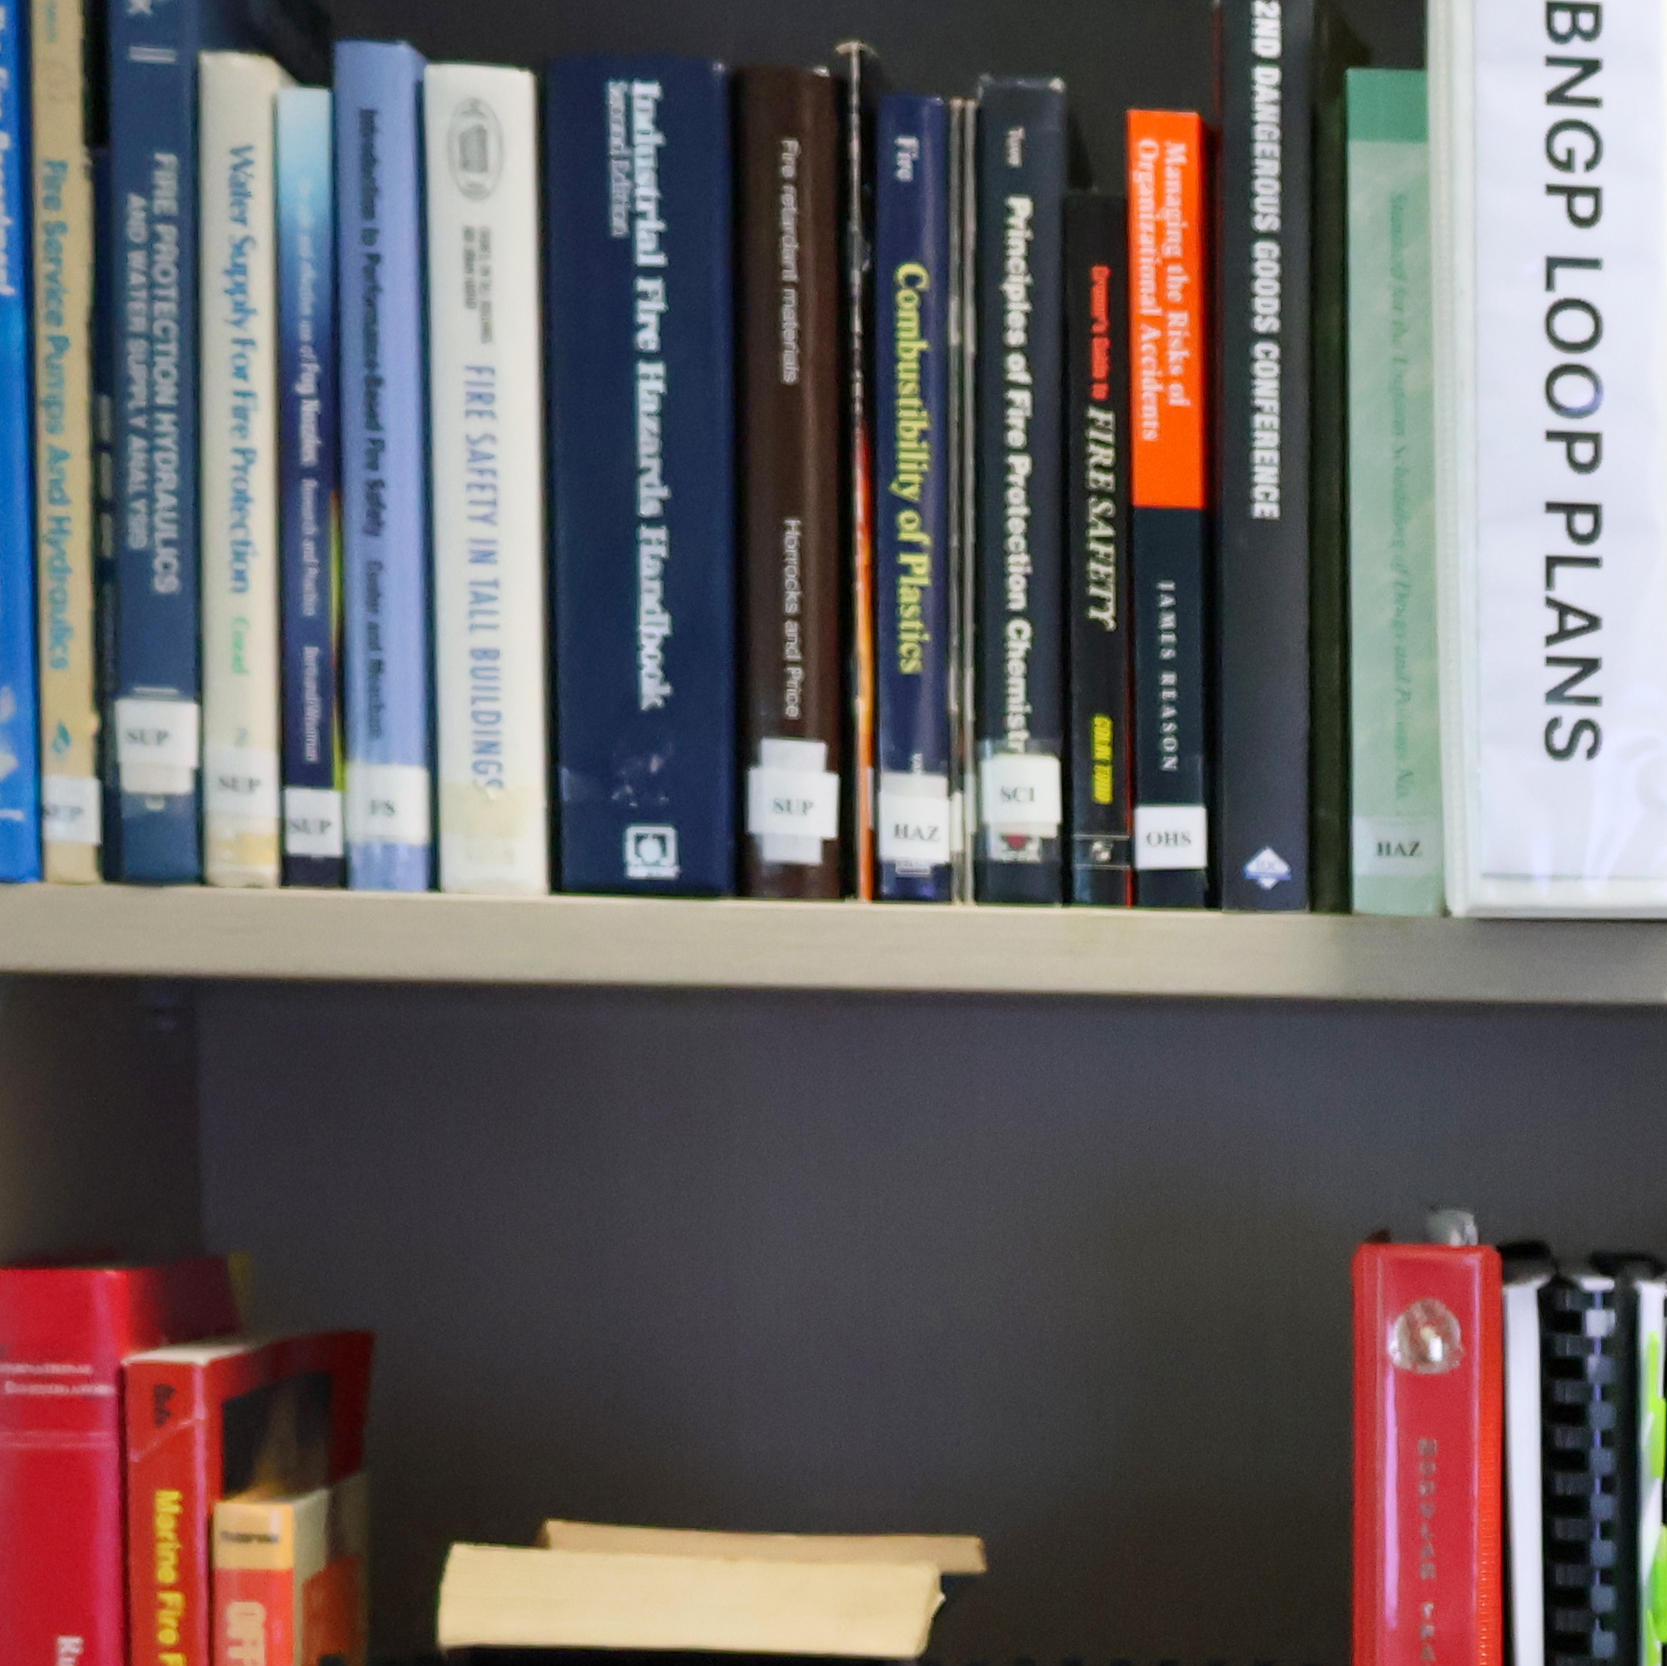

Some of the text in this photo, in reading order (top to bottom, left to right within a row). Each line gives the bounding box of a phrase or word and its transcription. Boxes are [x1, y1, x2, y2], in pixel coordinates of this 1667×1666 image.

[228, 144, 255, 226] Water
[894, 137, 918, 181] Fire
[1252, 66, 1280, 231] DANGEROUS
[224, 235, 256, 329] Supply
[779, 139, 802, 383] Fire retardant materials
[1134, 139, 1162, 441] Organizational Accidents
[1160, 142, 1191, 407] Managing the Risks of
[1252, 241, 1280, 333] GOODS
[152, 153, 180, 592] FIRE PROTECTION HYDRAULICS
[231, 390, 256, 439] Fire
[464, 365, 496, 418] FIRE
[630, 81, 671, 710] Industrial Fire Hazards Handbook
[1251, 341, 1280, 518] CONFERENCE
[1544, 0, 1604, 762] BNGP LOOP PLANS
[465, 433, 498, 525] SAFETY
[890, 263, 930, 673] Combustibility of Plastics
[1002, 195, 1032, 756] Principles of Fire Protection Chemistr
[1088, 407, 1114, 489] FIRE
[229, 448, 256, 594] Protection
[468, 538, 499, 564] IN
[1087, 498, 1116, 631] SAFETY
[469, 579, 500, 632] TALL
[783, 520, 804, 719] Horrocks and Price
[469, 648, 503, 793] BUILDINGS
[1157, 581, 1178, 772] JAMES REASON
[894, 824, 939, 842] HAZ
[1146, 829, 1191, 848] OHS
[1377, 841, 1420, 858] HAZ
[152, 1490, 183, 1585] Marine
[156, 1593, 185, 1644] Fire
